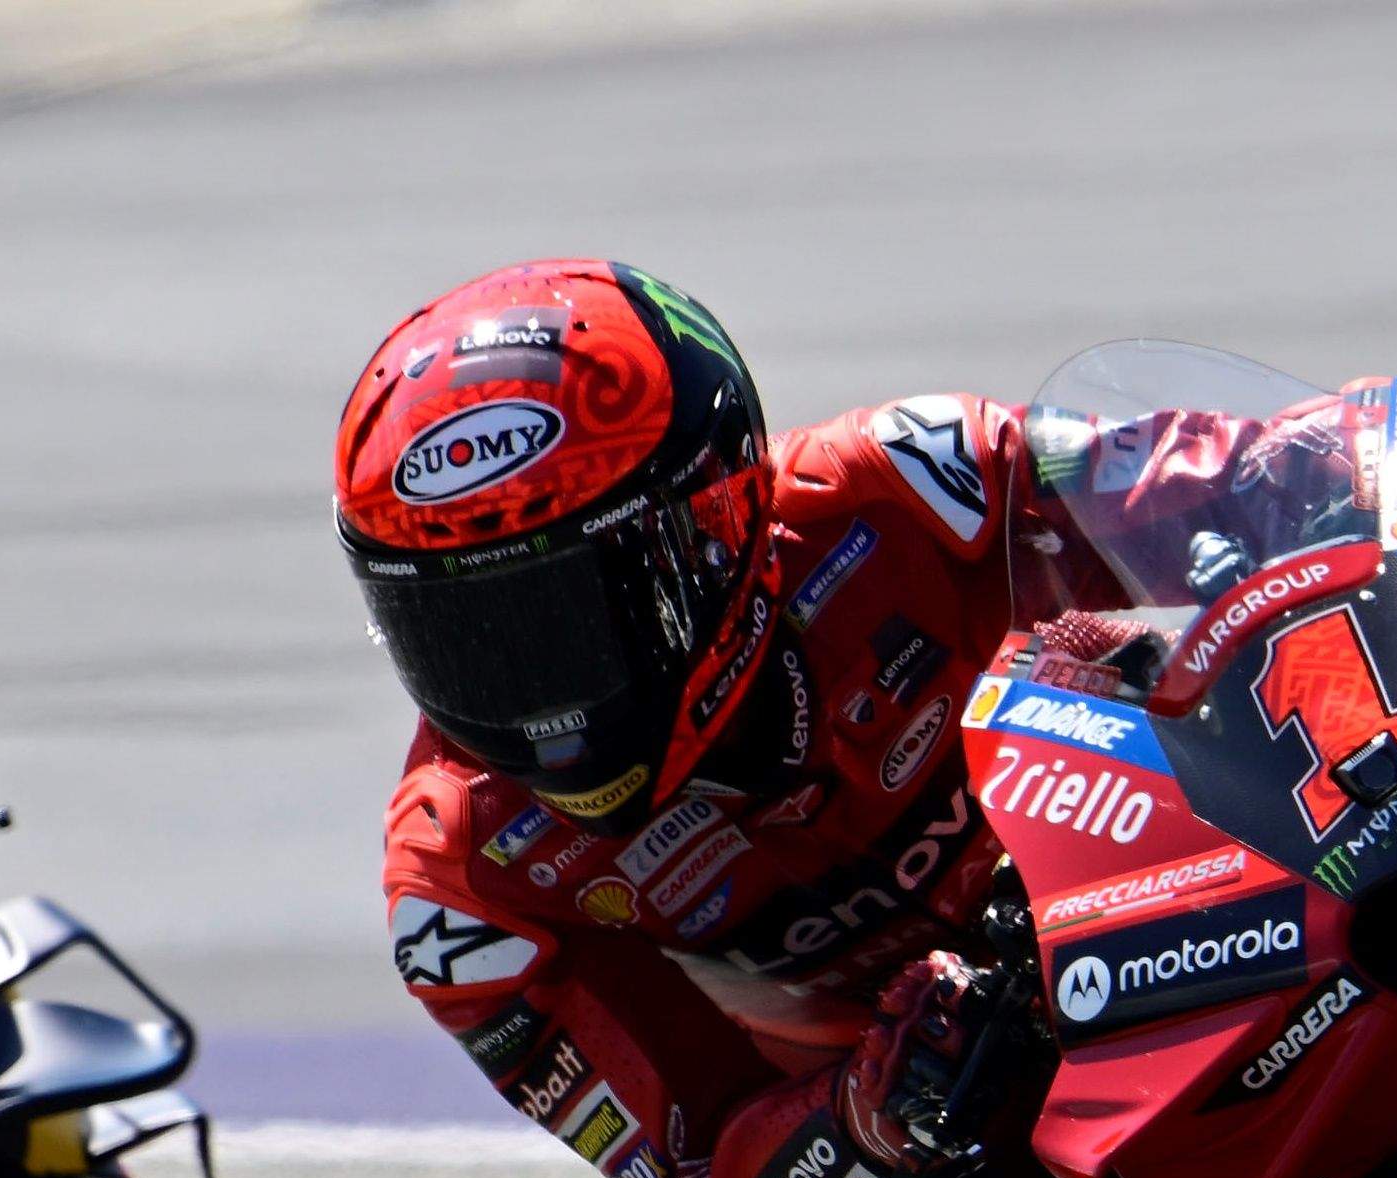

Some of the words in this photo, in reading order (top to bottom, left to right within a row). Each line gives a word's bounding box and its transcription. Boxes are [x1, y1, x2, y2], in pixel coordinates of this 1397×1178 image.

[460, 331, 550, 350] Lnovo
[404, 424, 545, 480] SUOMY
[877, 637, 924, 688] Lenovo
[782, 650, 809, 766] Lenovo
[884, 699, 947, 786] SUOMY
[644, 800, 711, 857] riello
[1004, 761, 1153, 844] riello
[723, 785, 969, 973] Lenov
[1042, 848, 1247, 923] FRECCIAROSSA
[1119, 919, 1300, 992] motorola
[1242, 978, 1362, 1089] CARRERA
